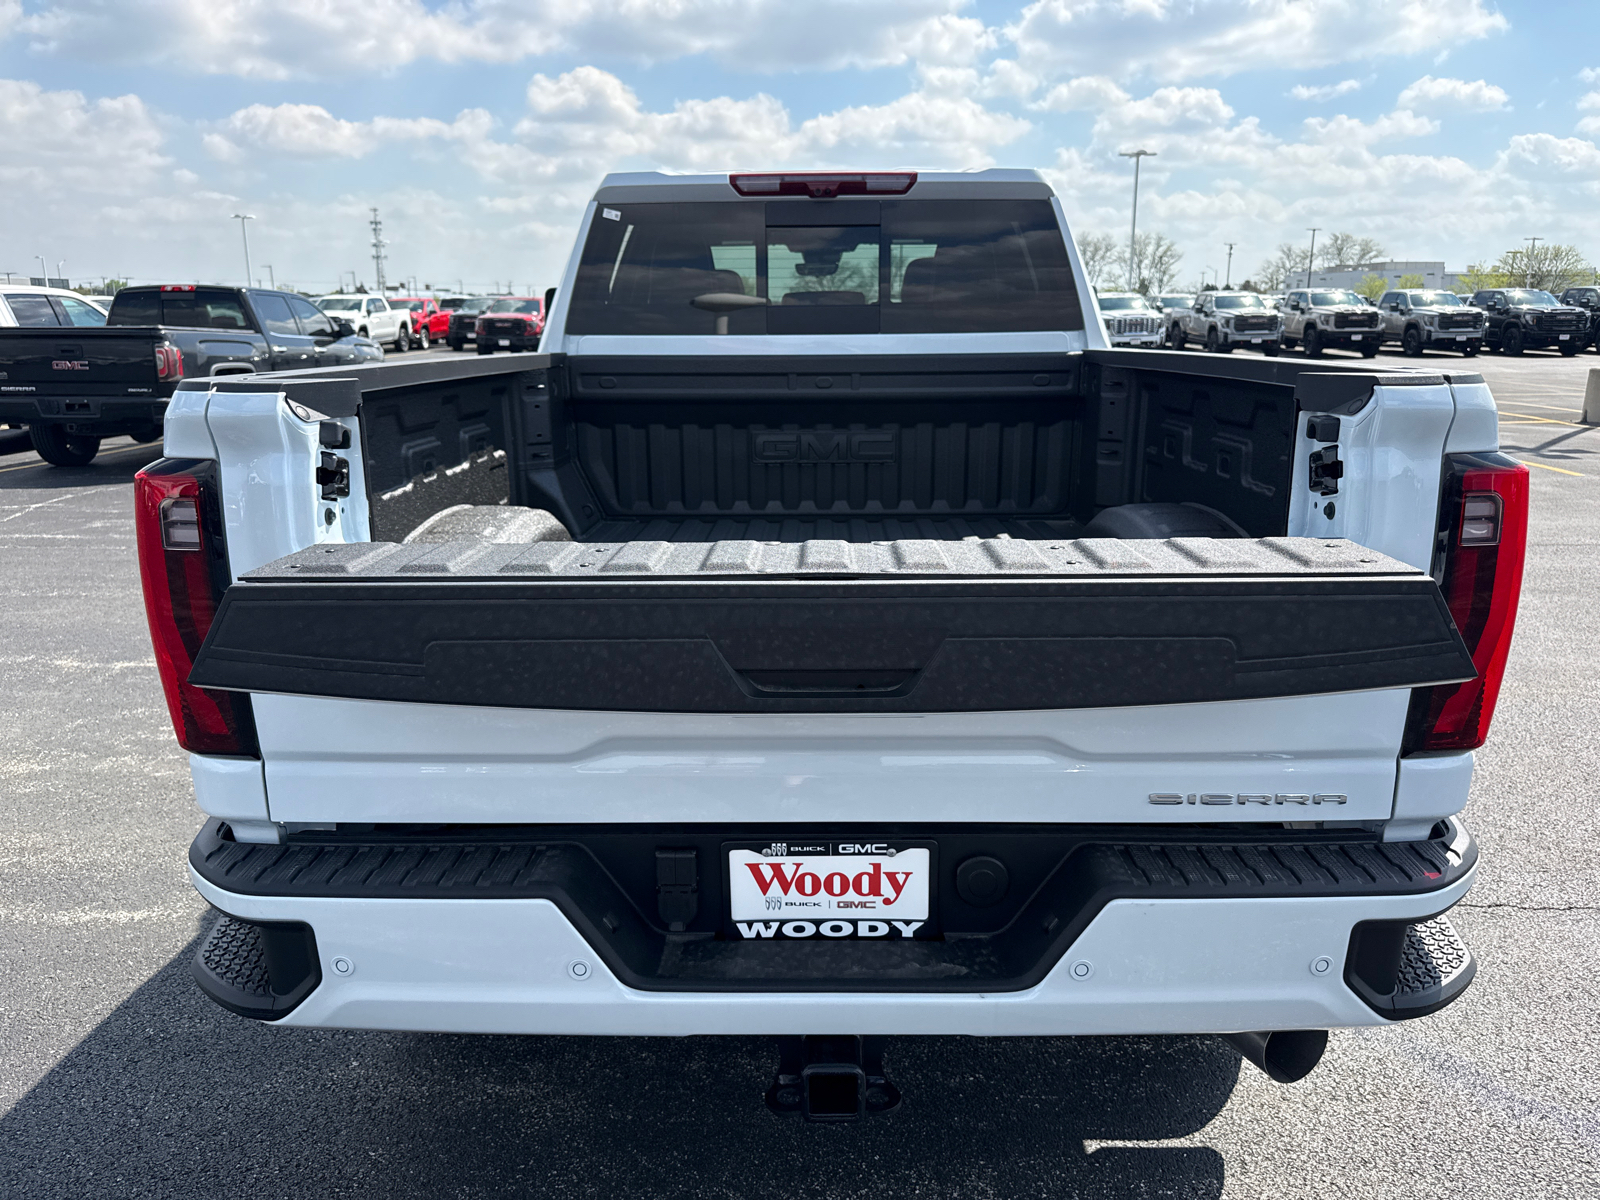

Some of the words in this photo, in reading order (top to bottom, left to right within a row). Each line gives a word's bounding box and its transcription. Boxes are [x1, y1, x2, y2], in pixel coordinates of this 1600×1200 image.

[52, 360, 90, 371] GMC
[754, 433, 894, 461] GMC
[1148, 792, 1348, 805] SIERRA
[838, 843, 888, 854] GMC
[744, 862, 914, 906] Woody
[836, 900, 877, 909] GMC
[735, 920, 925, 939] WOODY
